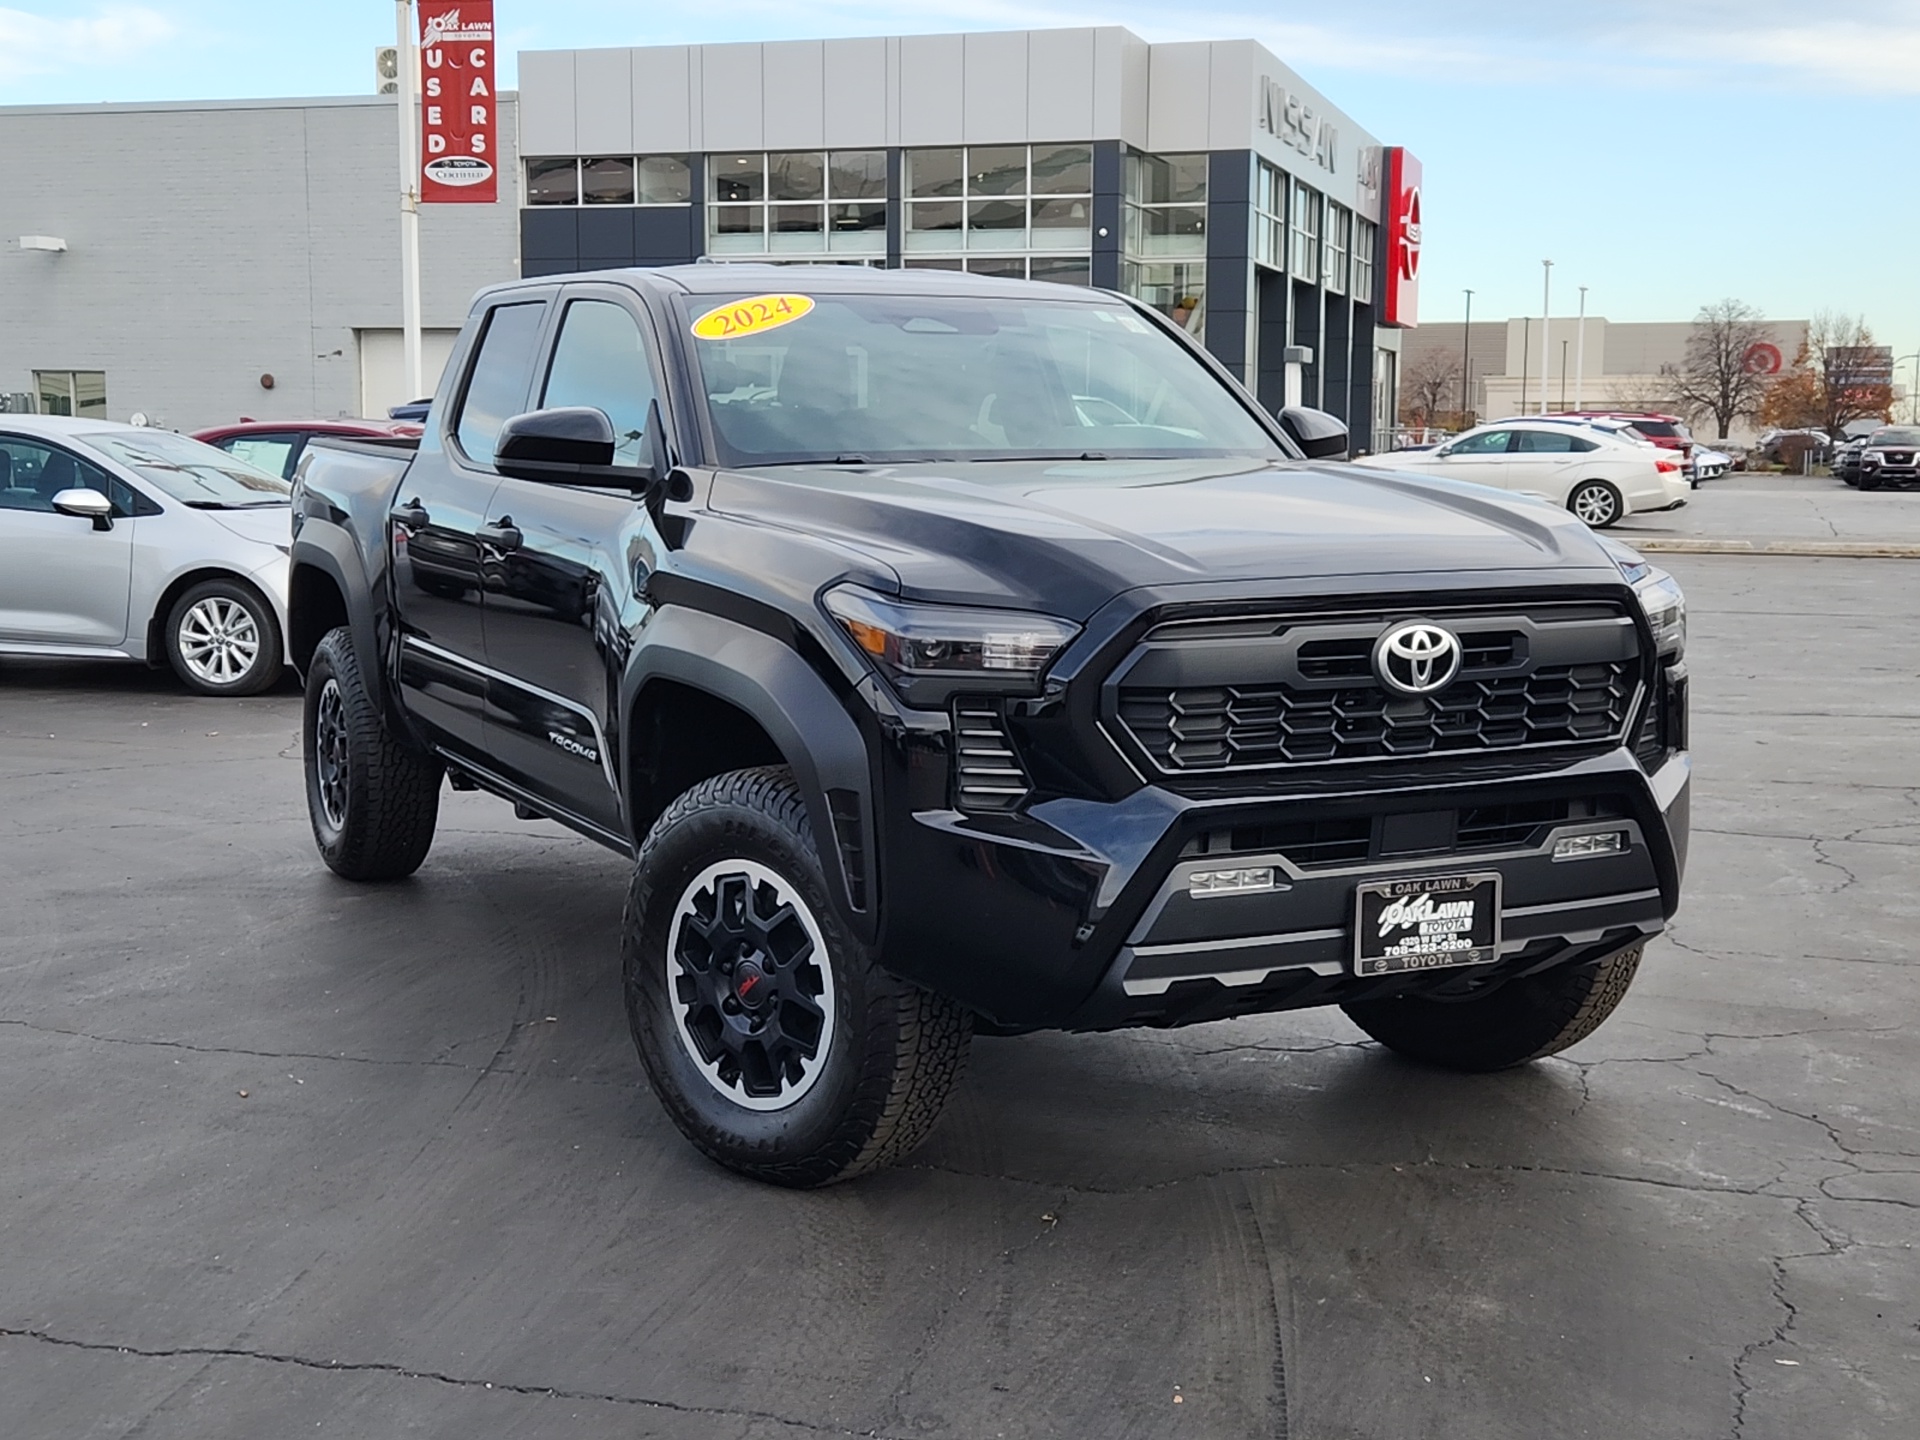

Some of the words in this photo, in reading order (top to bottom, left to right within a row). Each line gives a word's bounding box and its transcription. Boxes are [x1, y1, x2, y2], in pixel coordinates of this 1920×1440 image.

[462, 22, 491, 31] LAWN
[426, 49, 446, 153] USED
[469, 48, 489, 153] CARS
[1258, 75, 1339, 174] NISSAN
[714, 297, 792, 335] 2024
[1395, 882, 1422, 894] OAK
[1425, 879, 1461, 891] LAWN
[1427, 920, 1465, 932] TOYOTA
[1401, 953, 1453, 968] TOYOTA
